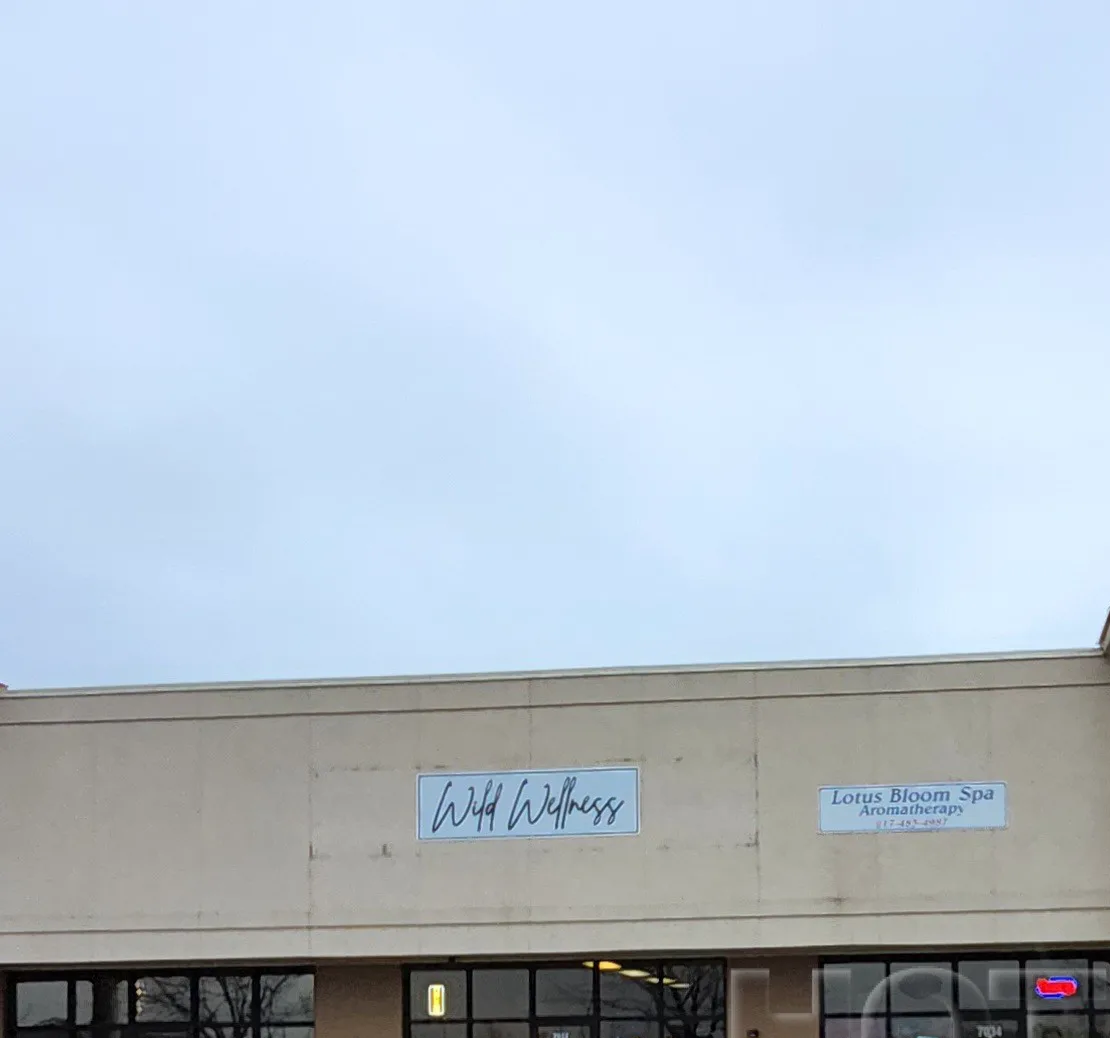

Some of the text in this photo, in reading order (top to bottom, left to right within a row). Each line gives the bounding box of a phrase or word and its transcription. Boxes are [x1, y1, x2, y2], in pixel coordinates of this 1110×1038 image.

[432, 776, 625, 833] Wild Wellness
[831, 786, 995, 805] Lotus Bloom Spa
[858, 803, 964, 817] Aromatherapy
